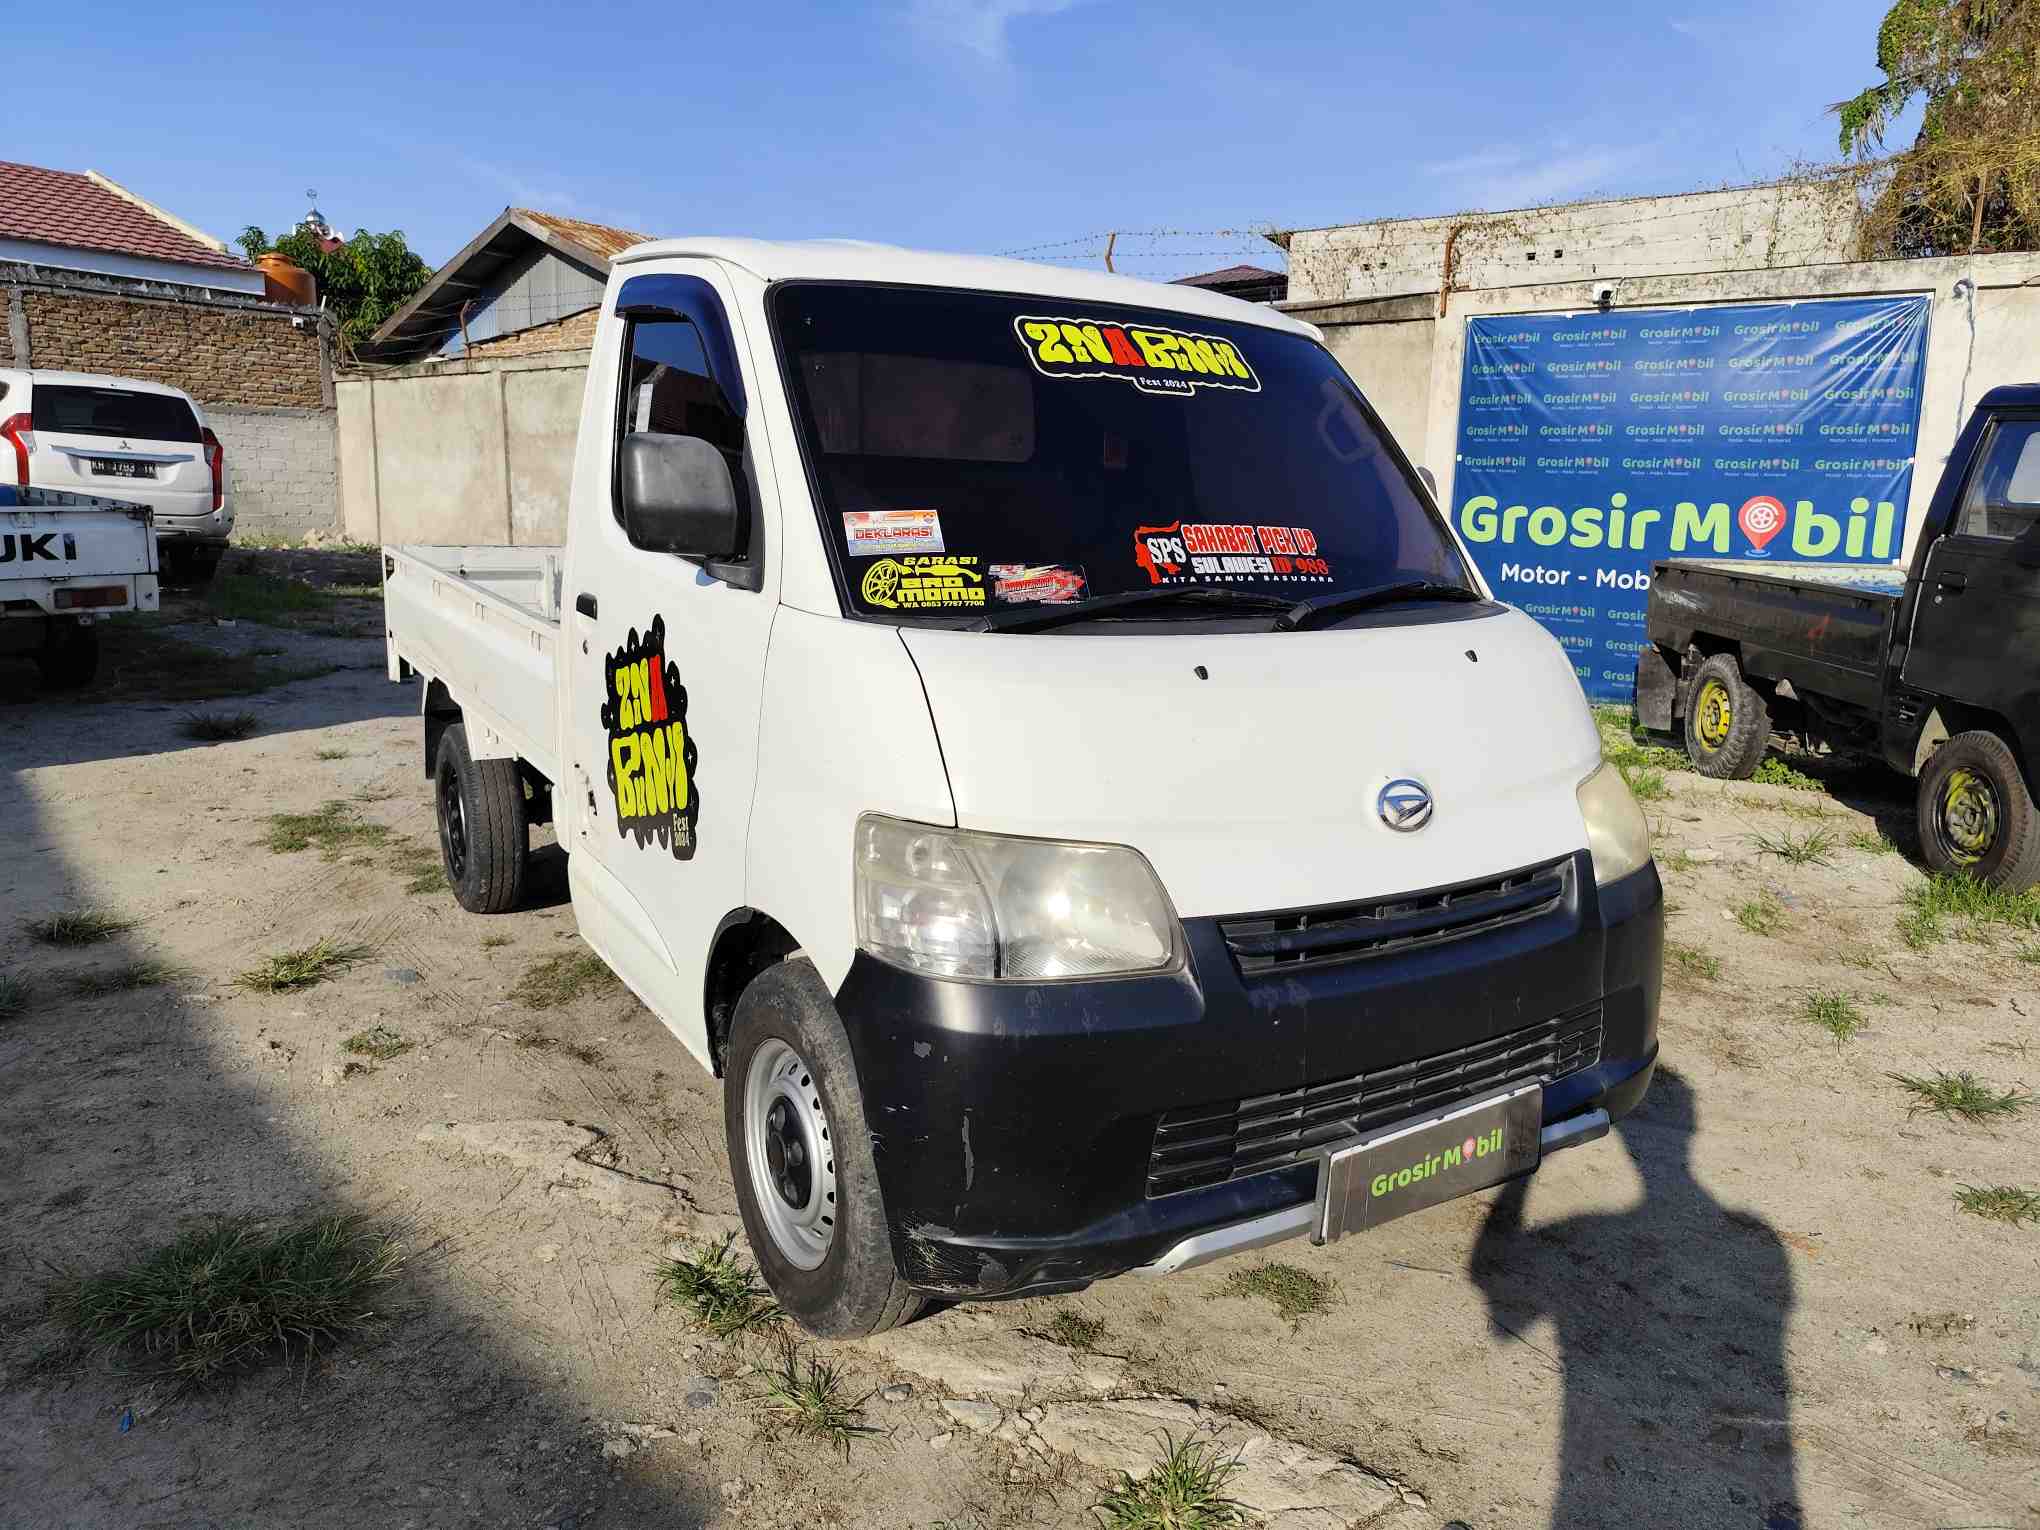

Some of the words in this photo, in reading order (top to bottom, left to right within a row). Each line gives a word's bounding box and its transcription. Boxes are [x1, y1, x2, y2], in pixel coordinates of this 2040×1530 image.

[1140, 377, 1161, 387] Fest
[1163, 378, 1187, 389] 2024
[1460, 492, 1661, 551] Grosir
[855, 527, 934, 541] DEKLARASI
[1181, 525, 1259, 554] SAHABAT
[1257, 525, 1299, 555] PICK
[1292, 528, 1317, 556] UP
[1147, 537, 1186, 564] SPS
[904, 557, 978, 565] GARASI
[1191, 557, 1274, 574] SULAWESI
[1271, 557, 1292, 574] ID
[1296, 559, 1329, 575] 988
[1502, 563, 1571, 585] Motor
[1596, 568, 1650, 590] Mob
[897, 588, 985, 601] MOMO
[1603, 670, 1635, 682] Grosi
[673, 813, 689, 832] Fest
[1371, 1153, 1440, 1197] Grosir
[1444, 1128, 1502, 1170] Mobil
